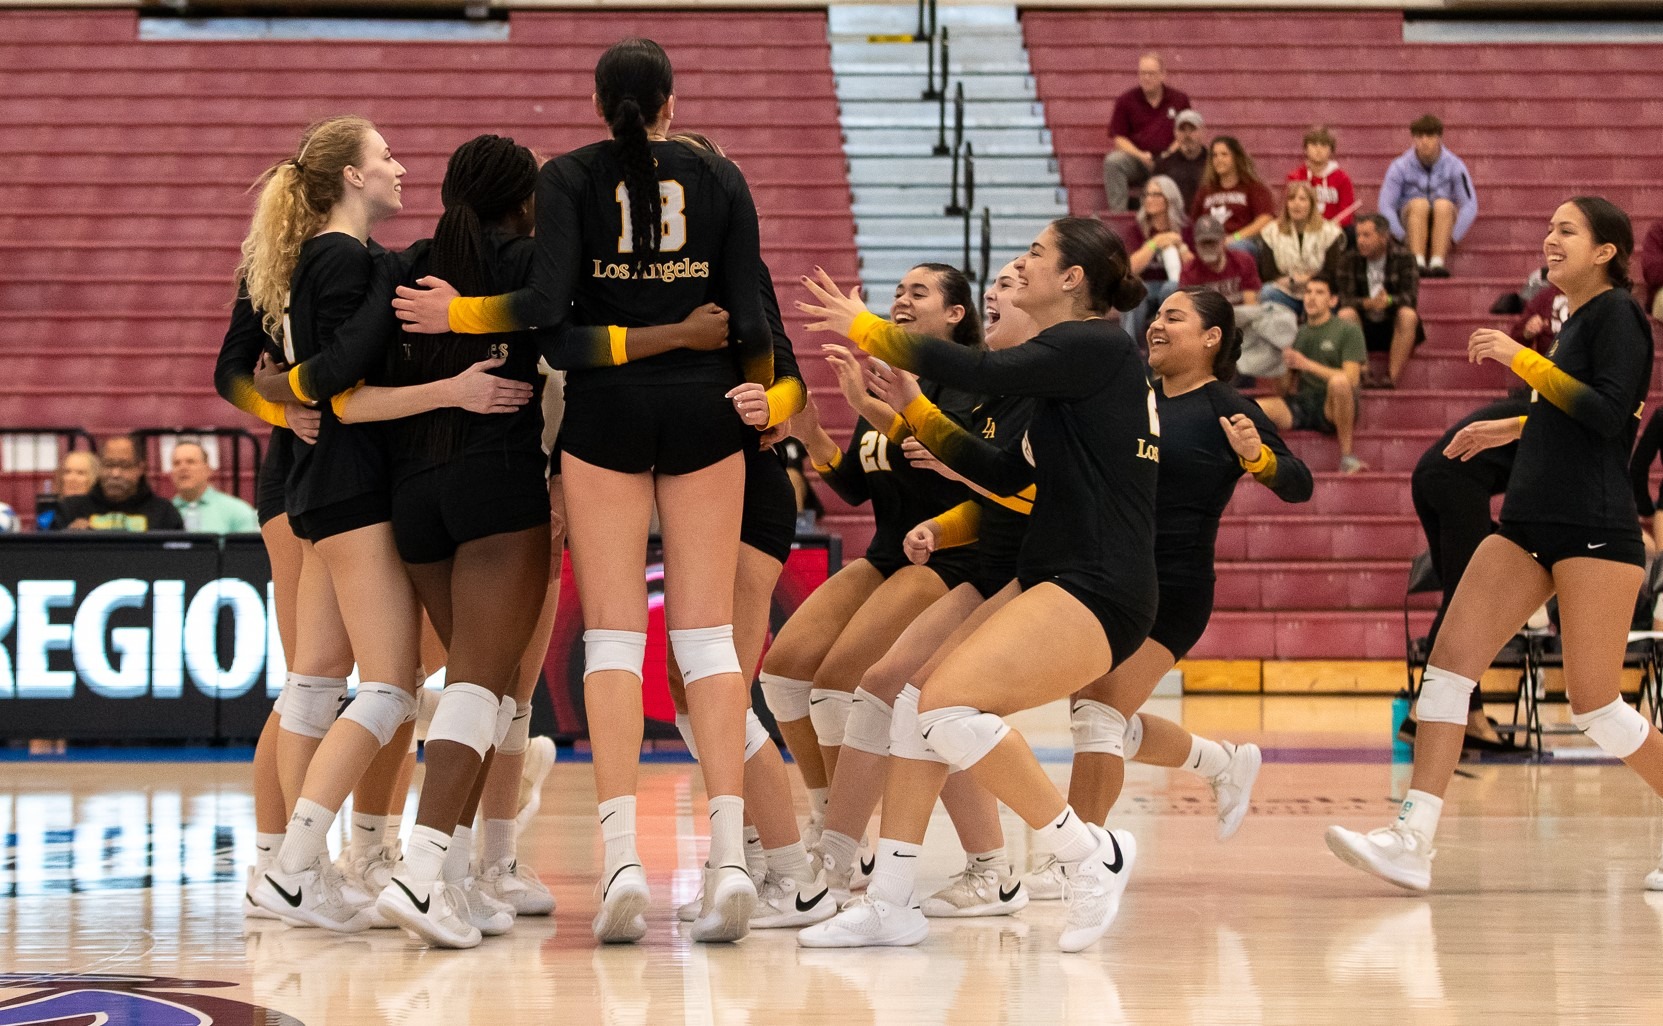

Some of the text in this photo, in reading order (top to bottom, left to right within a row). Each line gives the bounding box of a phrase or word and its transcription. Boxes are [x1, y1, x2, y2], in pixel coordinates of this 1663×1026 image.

[592, 259, 630, 280] Los
[982, 417, 996, 439] LA
[859, 430, 893, 474] 21
[0, 577, 288, 699] EGIO
